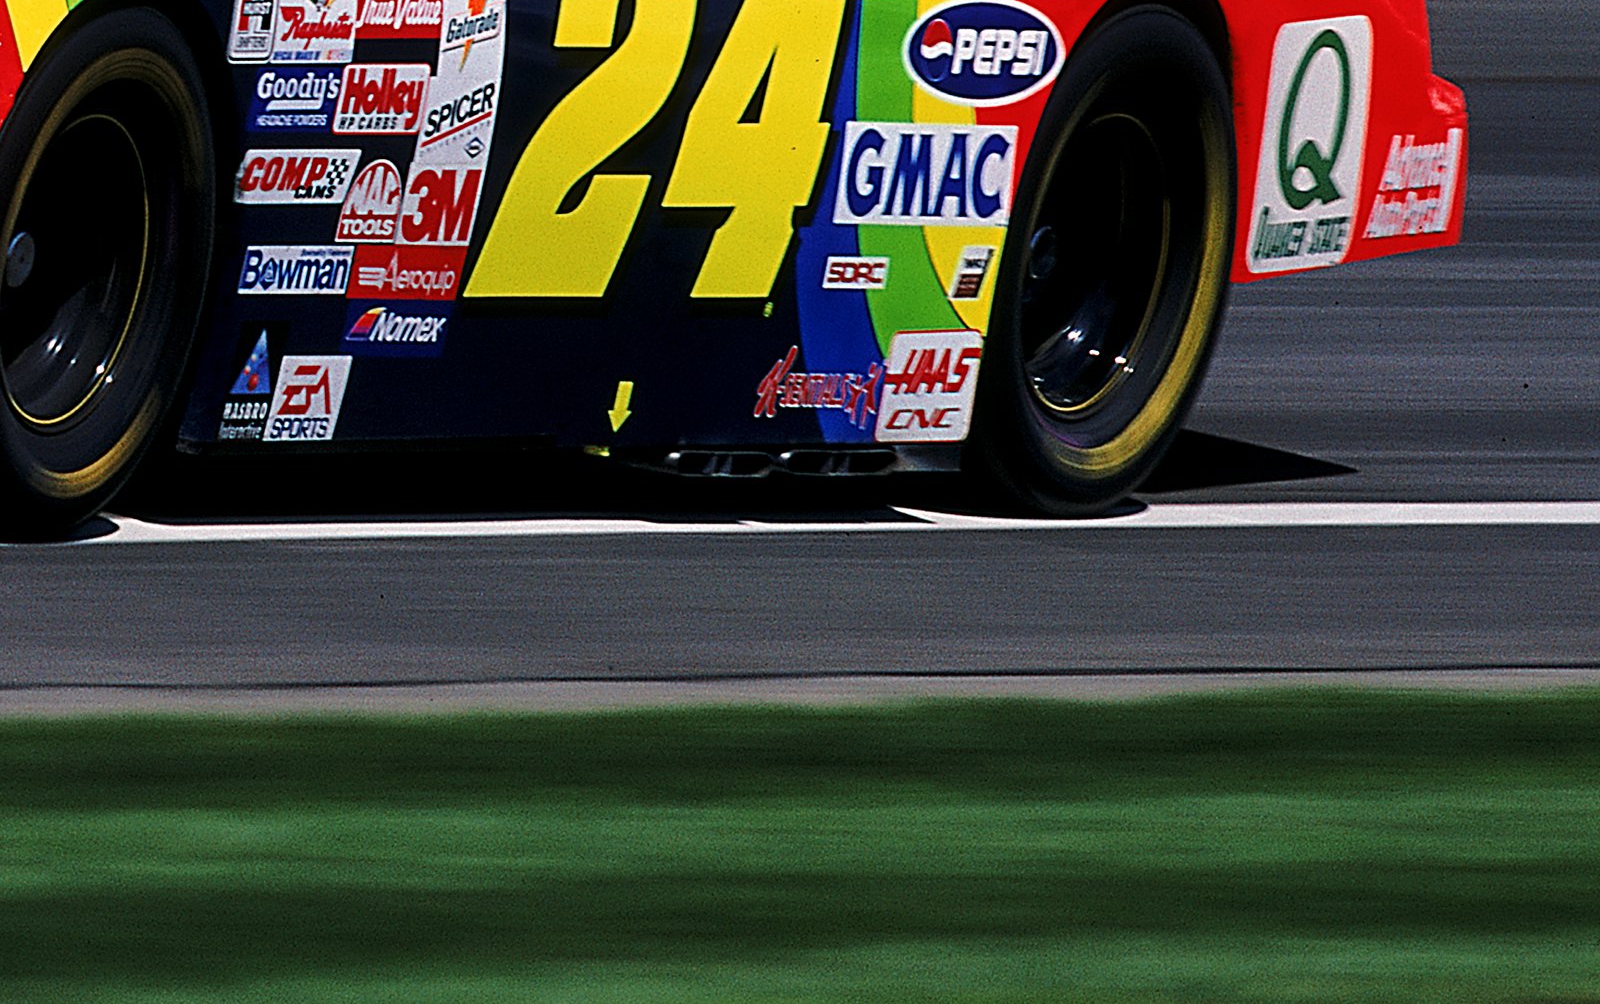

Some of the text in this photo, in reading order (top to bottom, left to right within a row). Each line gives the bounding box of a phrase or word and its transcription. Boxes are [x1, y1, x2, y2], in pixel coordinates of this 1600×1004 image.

[446, 9, 500, 44] Gatorade
[951, 28, 1050, 77] PEPSI
[256, 72, 341, 102] Goody's
[340, 68, 425, 130] Holley
[424, 82, 495, 137] SPICER
[1278, 29, 1351, 211] Q
[238, 156, 331, 191] COMP
[294, 185, 337, 199] CAMS
[847, 128, 1010, 218] GMAC
[341, 218, 395, 236] TOOLS
[401, 169, 483, 242] 3M
[383, 250, 455, 296] Aeroquip
[368, 311, 446, 343] Nomex
[277, 365, 332, 415] EA
[886, 347, 983, 395] HAAS
[269, 418, 330, 439] SPORTS
[885, 408, 961, 430] CNC
